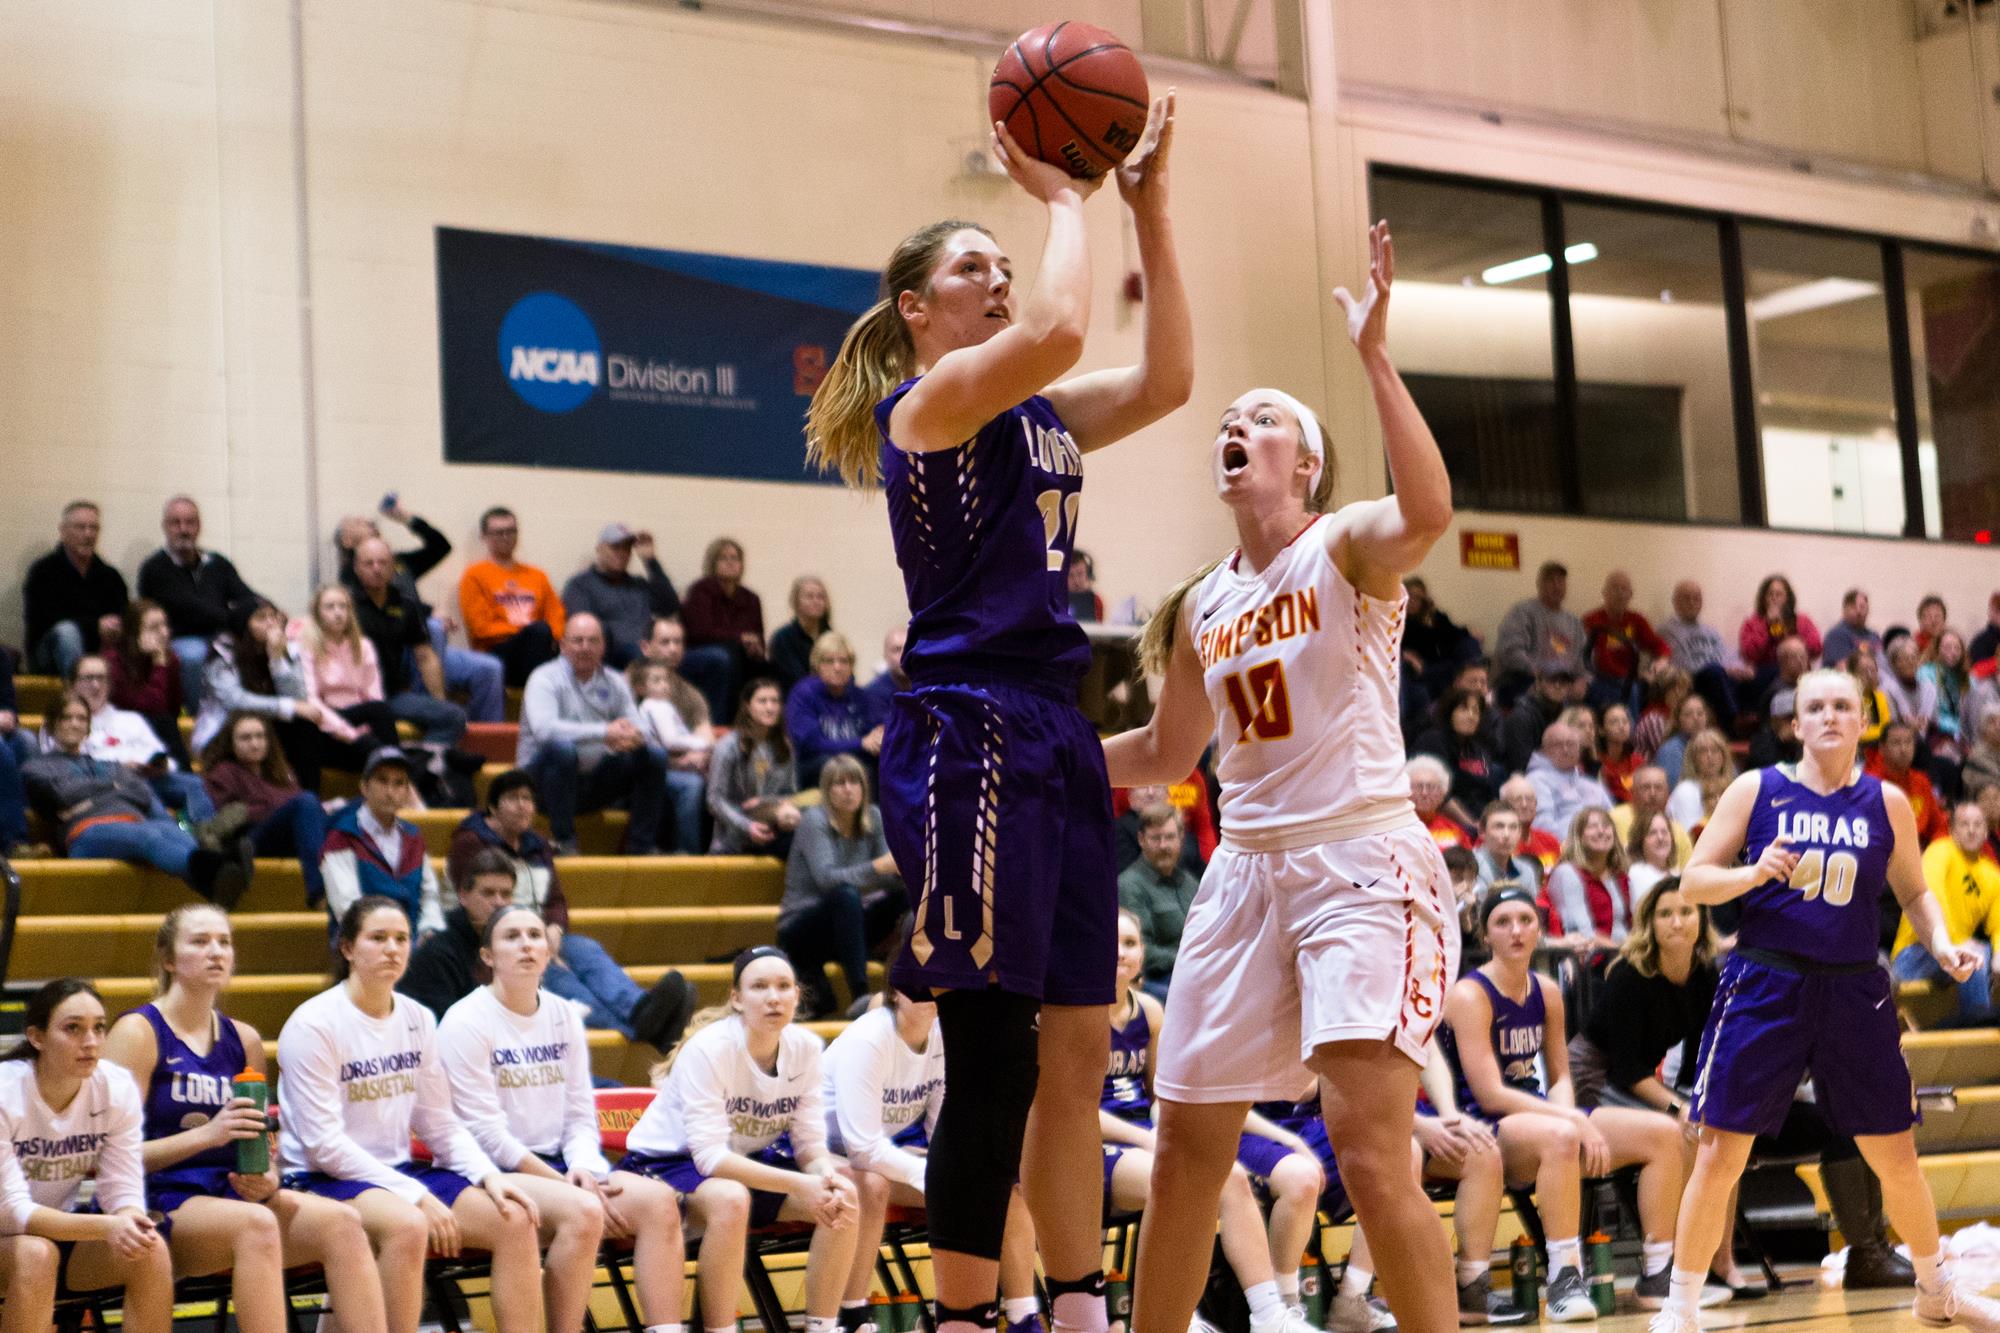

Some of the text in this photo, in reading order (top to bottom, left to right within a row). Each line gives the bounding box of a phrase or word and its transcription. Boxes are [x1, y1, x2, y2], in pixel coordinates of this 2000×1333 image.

[509, 346, 598, 385] NCAA
[607, 353, 737, 396] Division III
[1201, 585, 1321, 673] SIMPSON
[1222, 657, 1295, 745] 10
[1777, 811, 1869, 848] LORAS
[1788, 848, 1858, 906] 40
[944, 895, 962, 940] L
[171, 1071, 233, 1107] LORA
